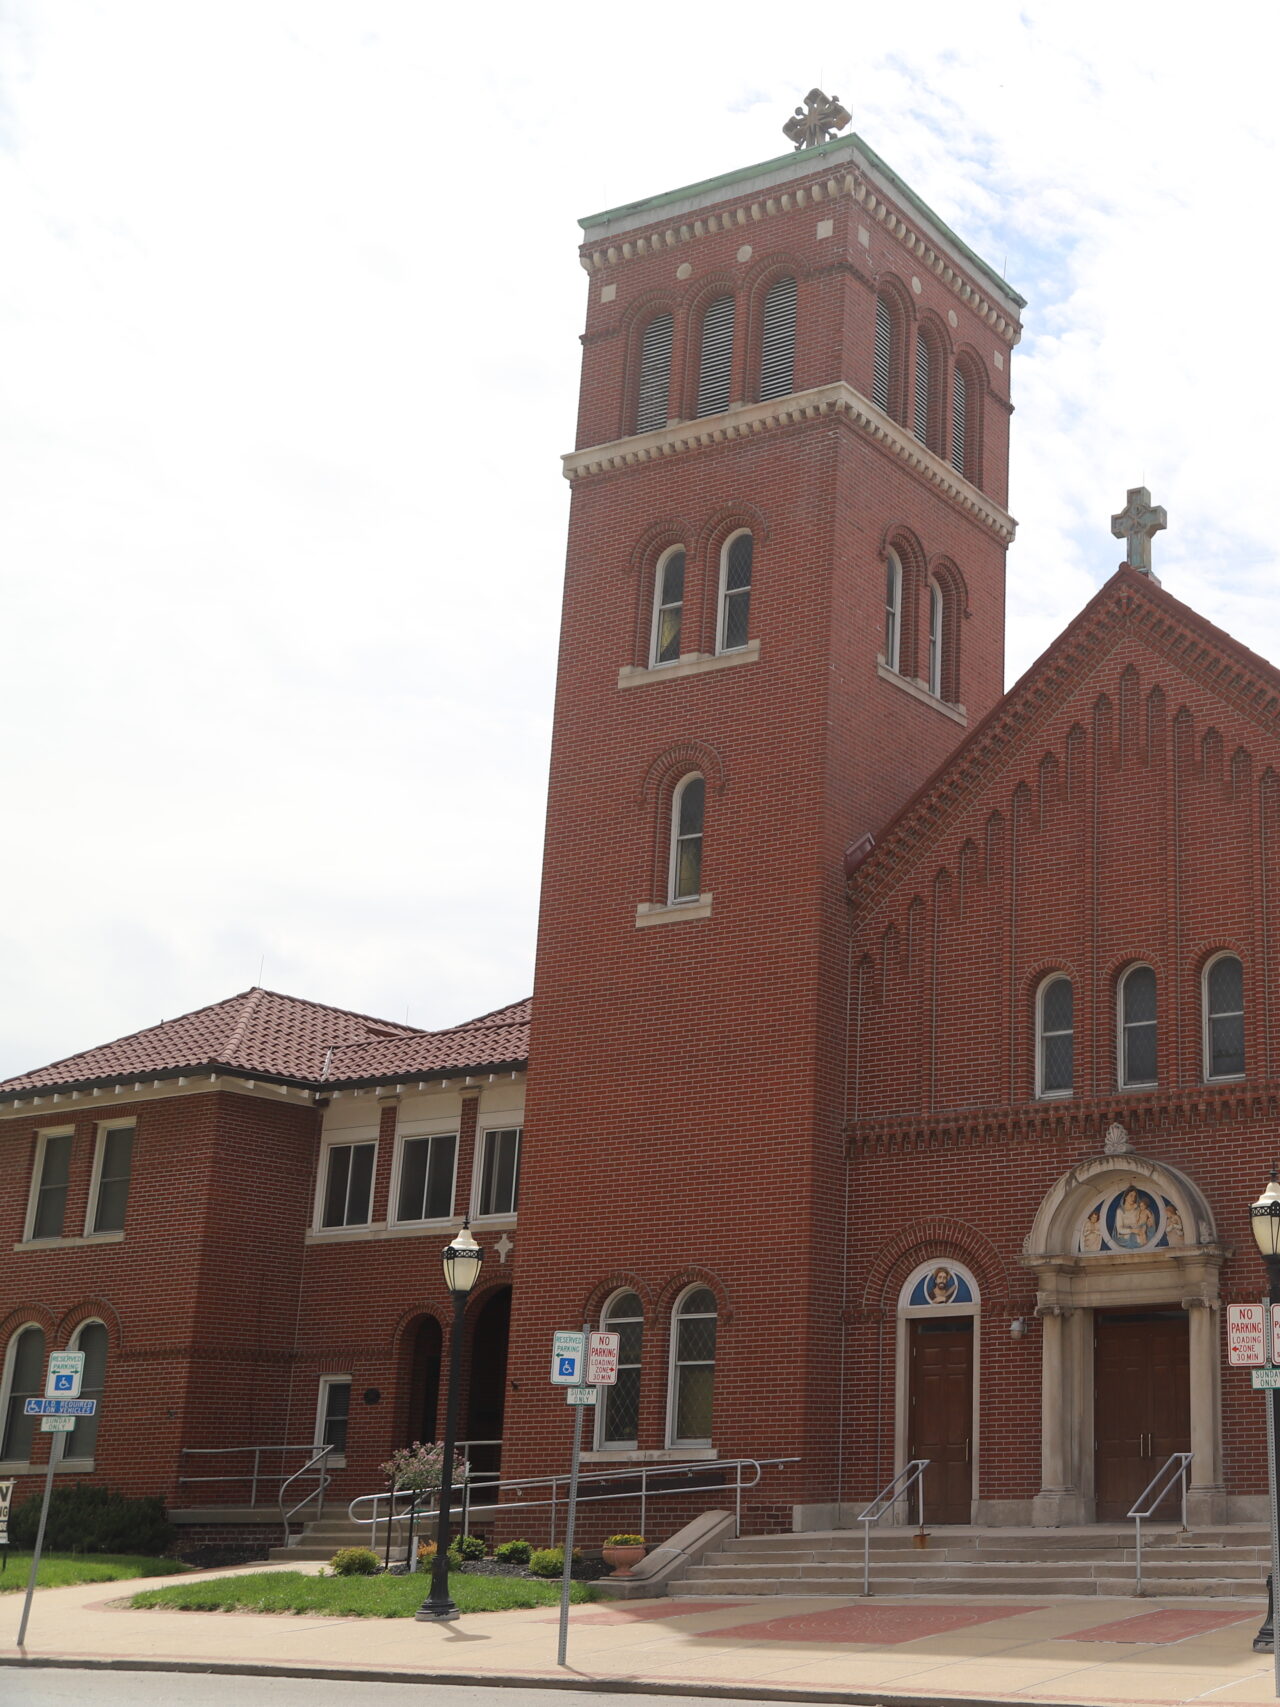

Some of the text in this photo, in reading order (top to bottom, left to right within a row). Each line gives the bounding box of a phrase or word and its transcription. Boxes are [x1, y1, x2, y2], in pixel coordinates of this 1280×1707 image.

[1239, 1308, 1253, 1320] NO
[1231, 1322, 1262, 1334] PARKING
[556, 1335, 582, 1345] RESERVED
[599, 1336, 610, 1346] NO
[1232, 1335, 1262, 1344] LOADING
[592, 1348, 616, 1358] PARKING
[1238, 1344, 1256, 1353] ZONE
[1236, 1352, 1259, 1362] 30 MIN
[591, 1359, 615, 1367] LOADING
[1260, 1379, 1278, 1387] ONLY
